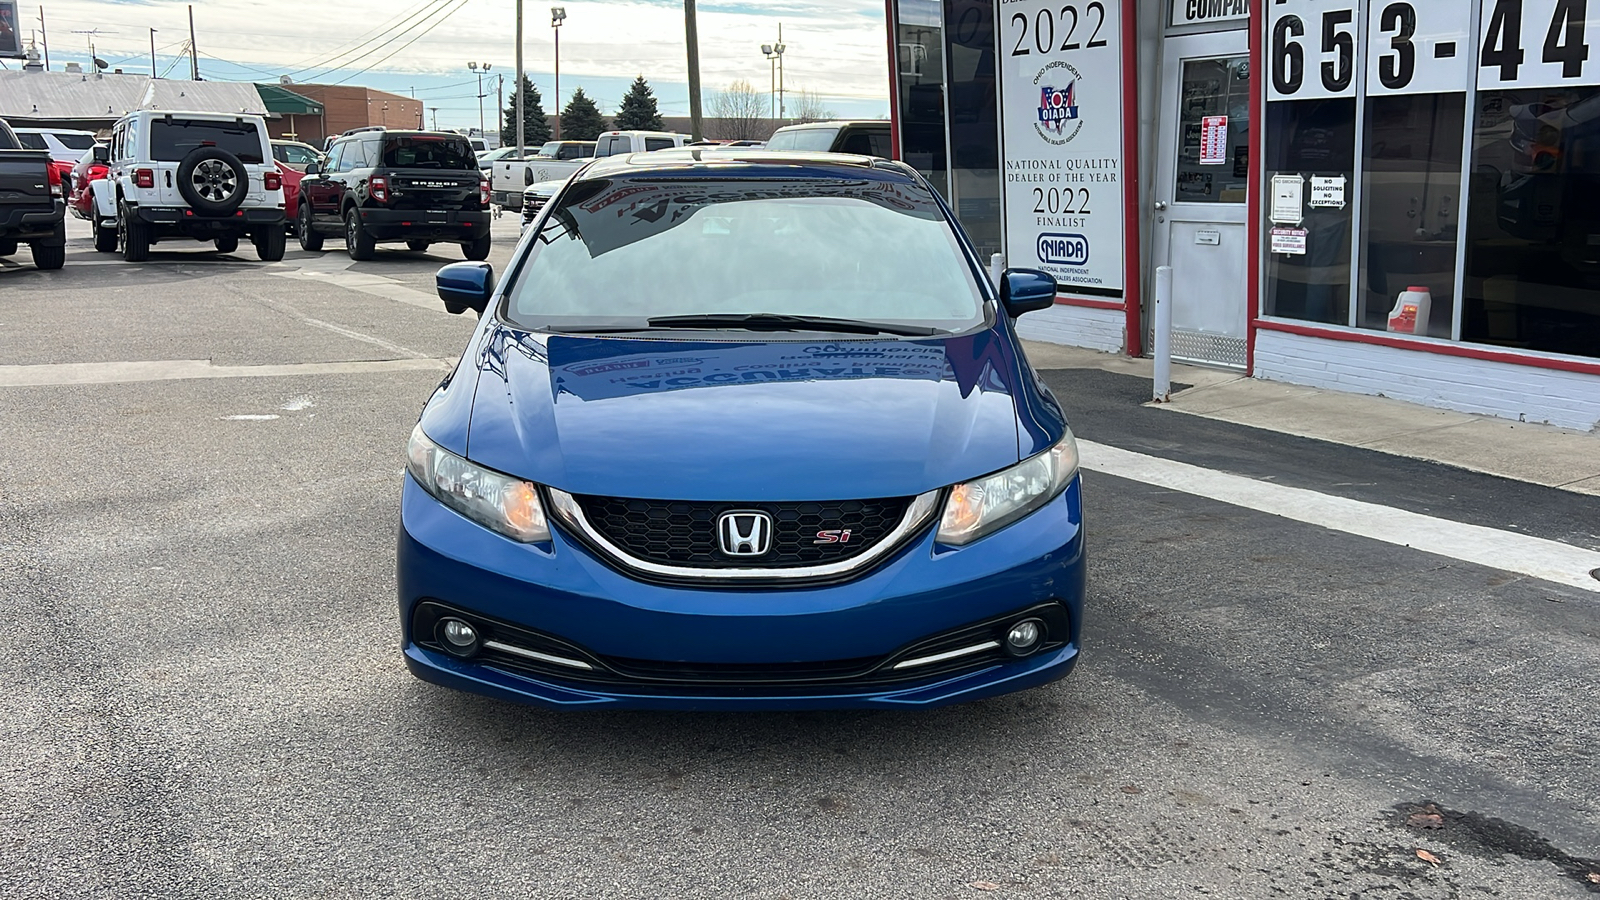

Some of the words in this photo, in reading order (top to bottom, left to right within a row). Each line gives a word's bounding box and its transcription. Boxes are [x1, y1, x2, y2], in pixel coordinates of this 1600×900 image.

[1012, 1, 1107, 56] 2022
[1033, 68, 1046, 85] OHIO
[1045, 60, 1083, 81] INDEPENDENT
[1042, 107, 1072, 120] OIADA
[1033, 122, 1051, 144] AUTOMOBILE
[1065, 119, 1084, 143] ASSOCIATION
[1006, 158, 1062, 171] NATIONAL
[1066, 158, 1119, 171] QUALITY
[1008, 173, 1044, 183] DEALER
[1048, 173, 1061, 182] OF
[1064, 173, 1085, 183] THE
[1089, 173, 1117, 183] YEAR
[1032, 187, 1091, 214] 2022
[1036, 217, 1086, 228] FINALIST
[1041, 240, 1084, 259] NIADA
[1072, 276, 1103, 284] ASSOCIATION
[813, 528, 852, 546] Si
